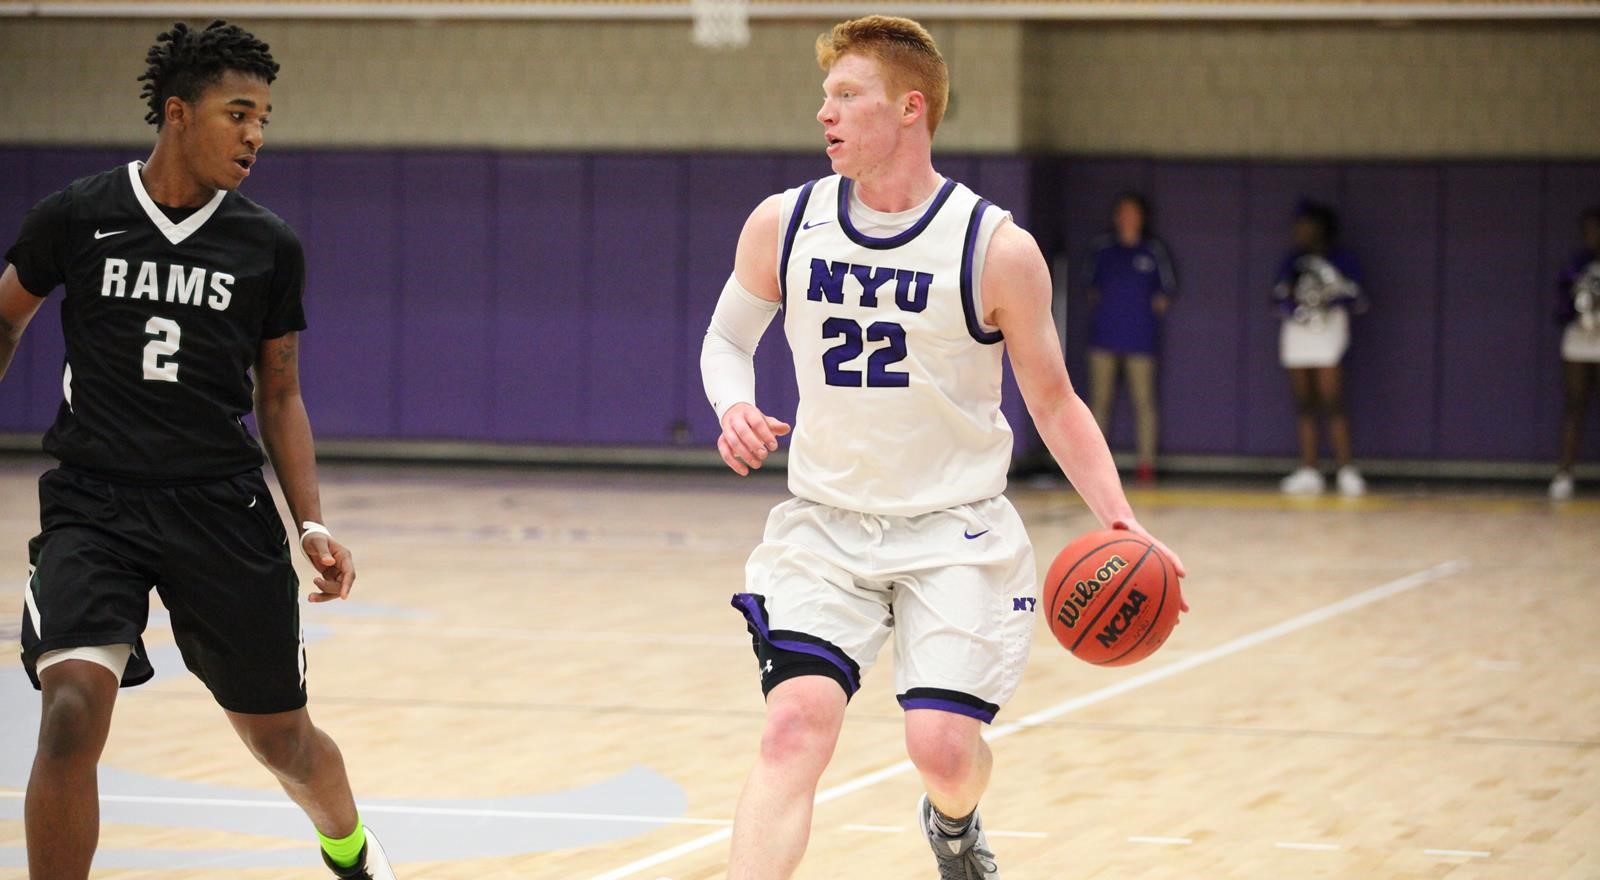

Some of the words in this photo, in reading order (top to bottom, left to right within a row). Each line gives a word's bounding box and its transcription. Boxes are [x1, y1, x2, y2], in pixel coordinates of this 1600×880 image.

[101, 258, 235, 311] RAMS
[807, 258, 934, 313] NYU
[142, 316, 181, 382] 2
[822, 317, 909, 387] 22
[1013, 597, 1037, 612] NY
[1057, 555, 1129, 629] Wilson
[1096, 589, 1148, 648] NCAA
